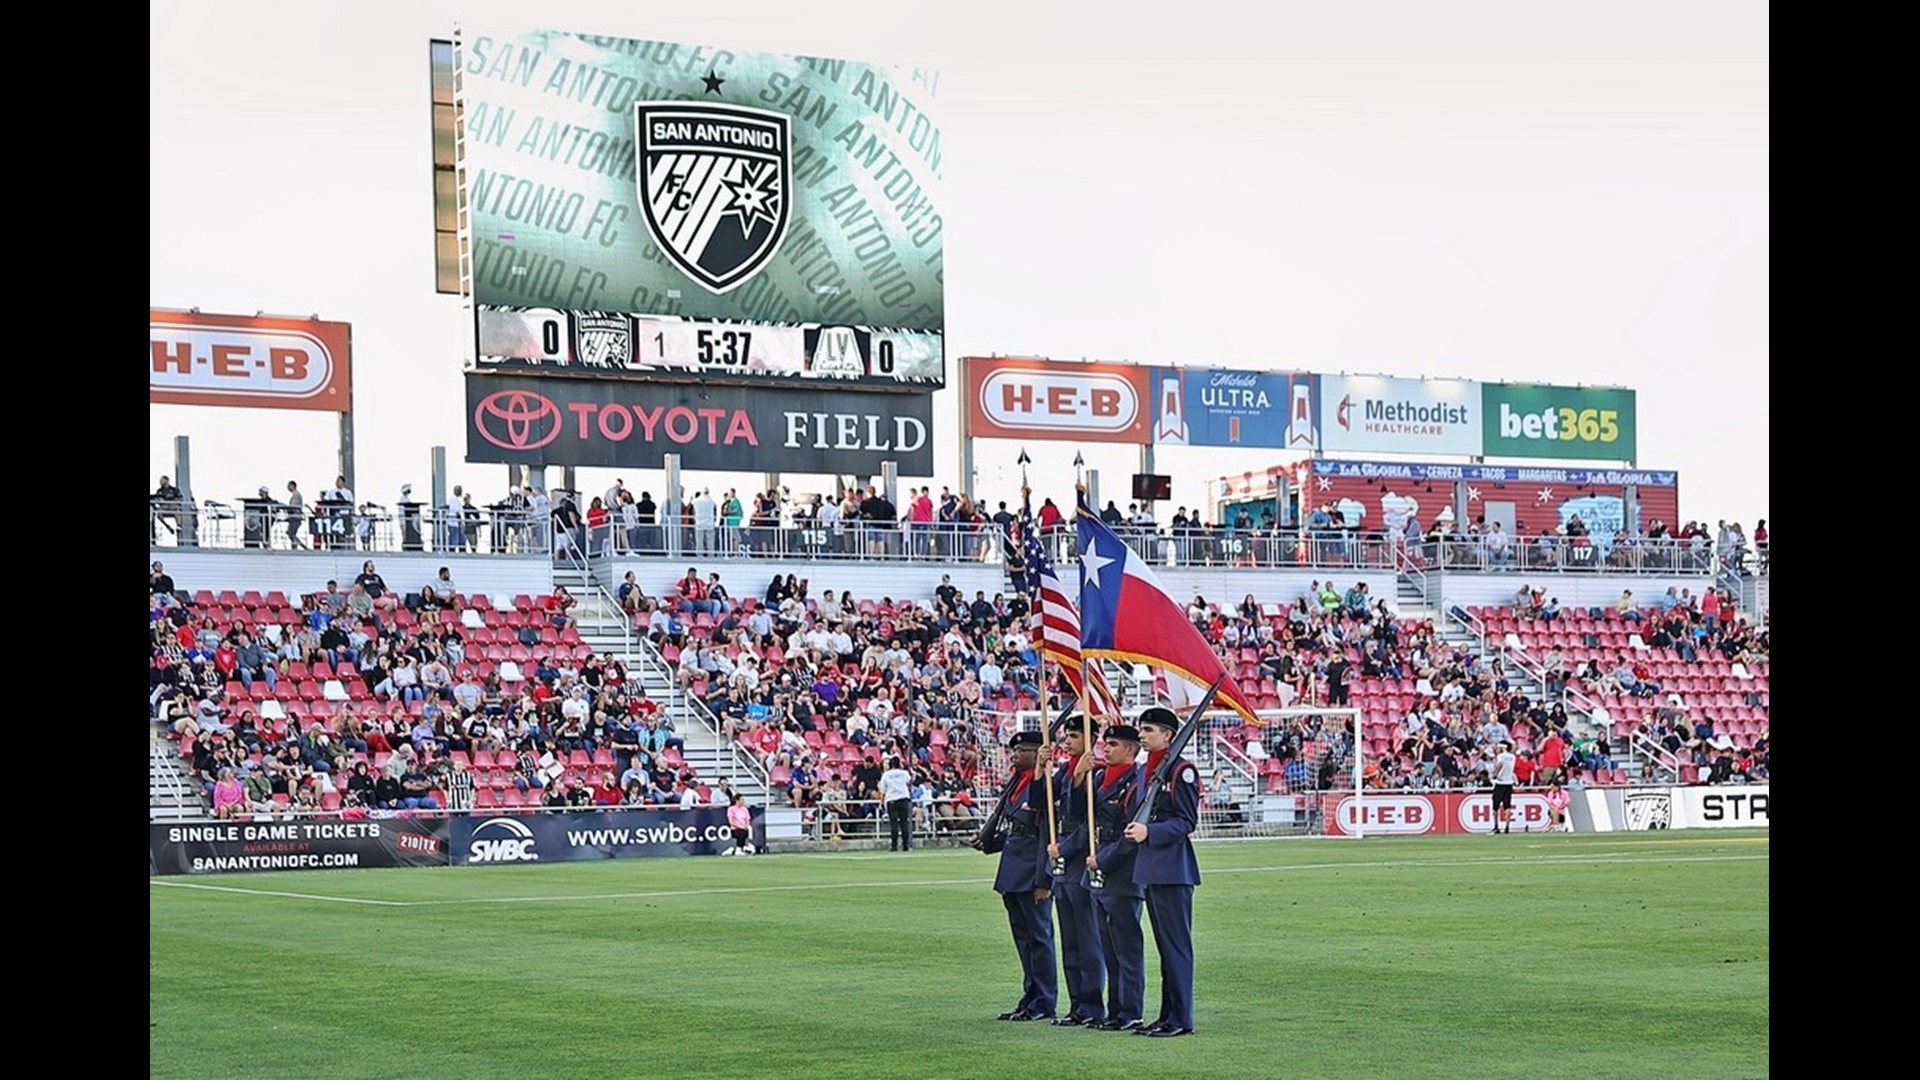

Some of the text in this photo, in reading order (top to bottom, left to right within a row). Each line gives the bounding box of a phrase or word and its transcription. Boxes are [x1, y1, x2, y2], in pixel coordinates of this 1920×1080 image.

[466, 36, 697, 118] SAN ANTON
[653, 122, 774, 149] SAN ANTONIO
[759, 71, 943, 248] SAN ANTONIO
[582, 199, 630, 247] FC
[819, 183, 916, 308] ANTONIO
[543, 320, 894, 373] 0 1 5:37 0
[152, 340, 309, 380] H-E-B
[1002, 384, 1121, 417] H-E-B
[1201, 387, 1270, 408] ULTRA
[1365, 399, 1468, 424] Methodist
[1500, 403, 1618, 442] bet365
[569, 403, 927, 452] TOYOTA FIELD
[1365, 423, 1443, 435] HEALTHCARE
[1339, 464, 1358, 475] LA
[1361, 463, 1411, 476] GLORIA
[1427, 466, 1463, 478] CERVEZA
[1481, 468, 1506, 479] TACOS
[1518, 469, 1567, 482] MARGARITAS
[314, 518, 345, 535] 114
[802, 530, 827, 545] 115
[1220, 539, 1243, 553] 116
[1573, 547, 1593, 560] 117
[1472, 805, 1541, 822] HE-B
[1703, 794, 1769, 821] STA
[169, 824, 380, 842] SINGLE GAME TICKETS
[243, 843, 294, 852] AVAILABLE
[193, 853, 358, 870] SANANTONIOFC.COM
